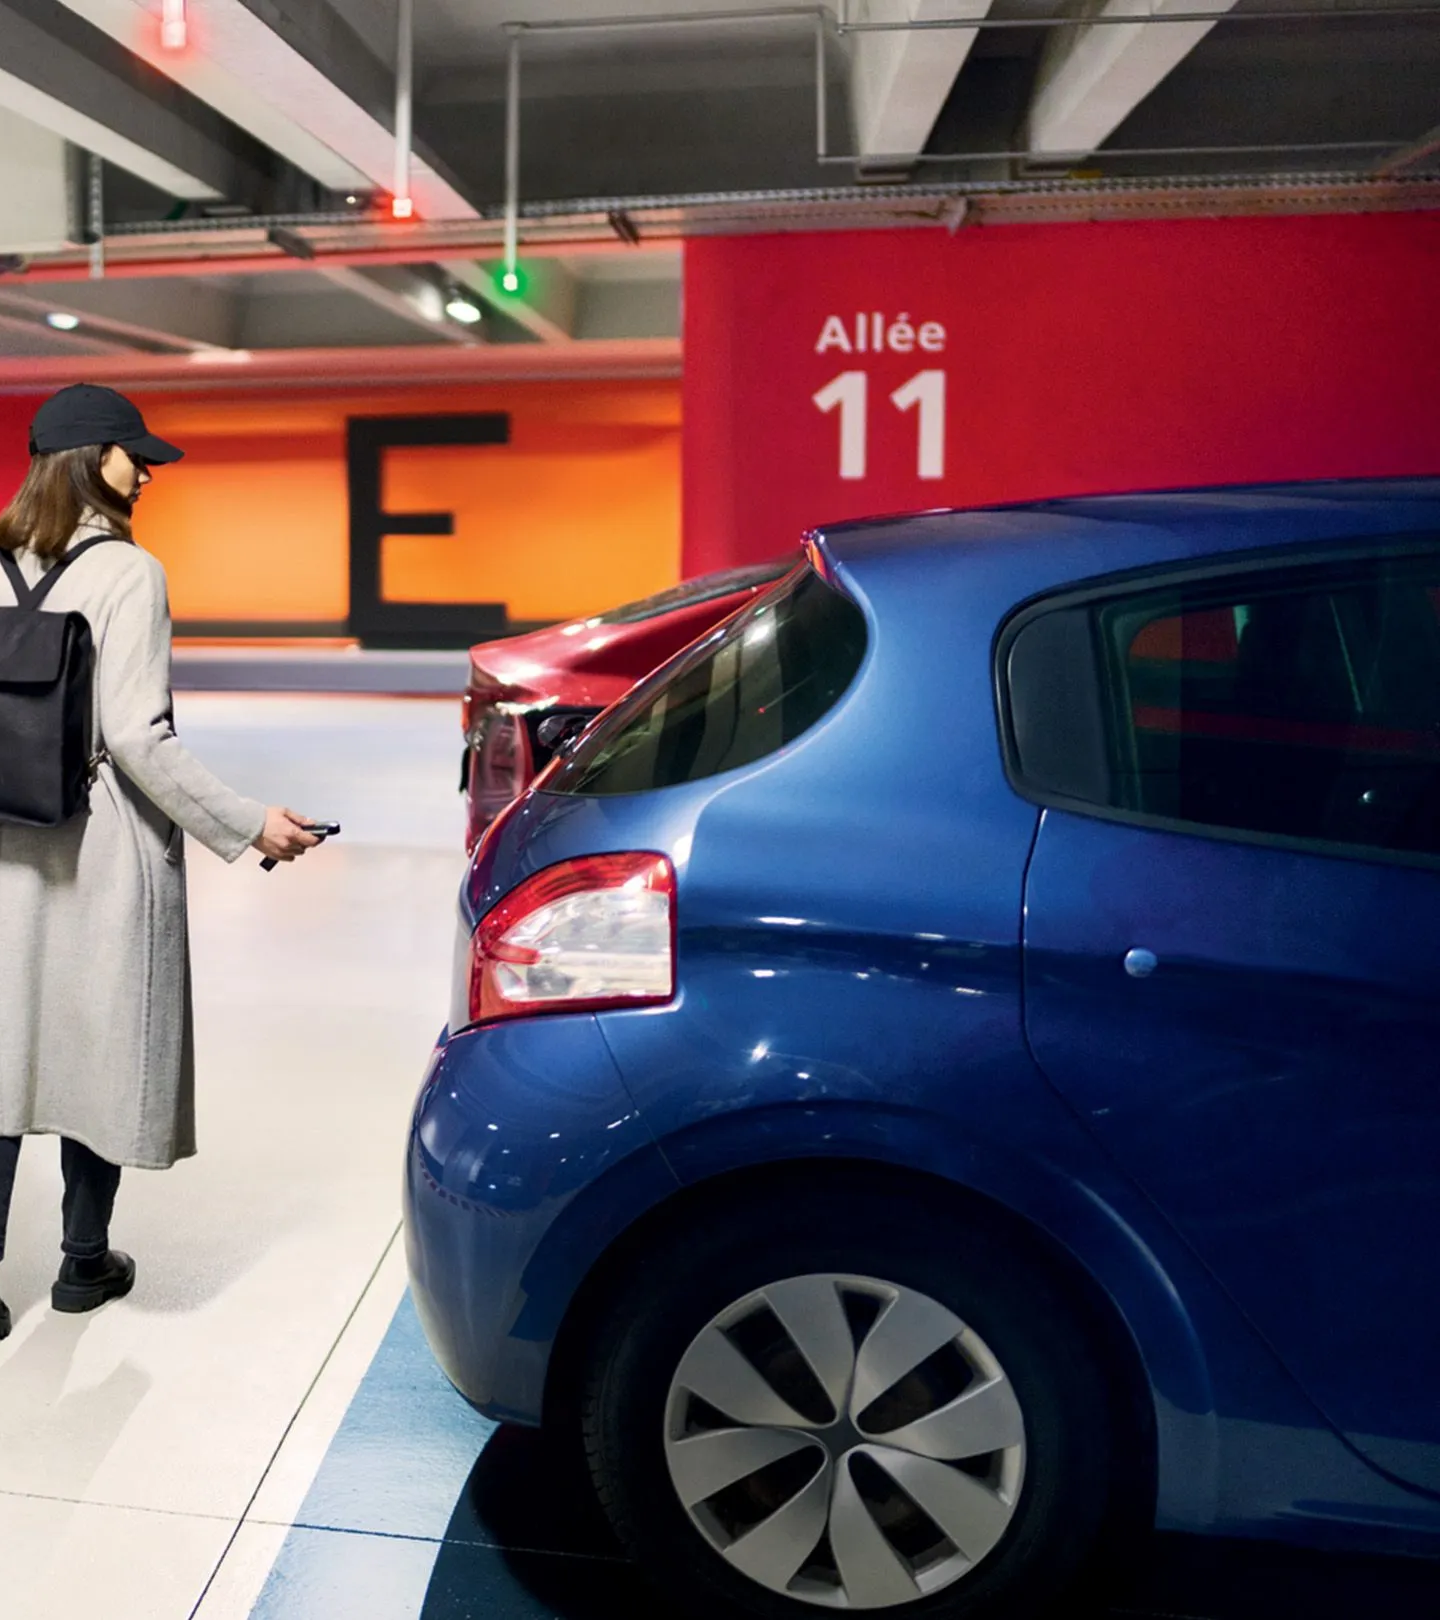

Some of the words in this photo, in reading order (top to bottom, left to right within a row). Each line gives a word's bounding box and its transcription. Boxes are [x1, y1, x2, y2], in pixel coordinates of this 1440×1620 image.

[815, 311, 946, 354] Allée
[812, 369, 946, 480] 11
[347, 413, 511, 649] E
